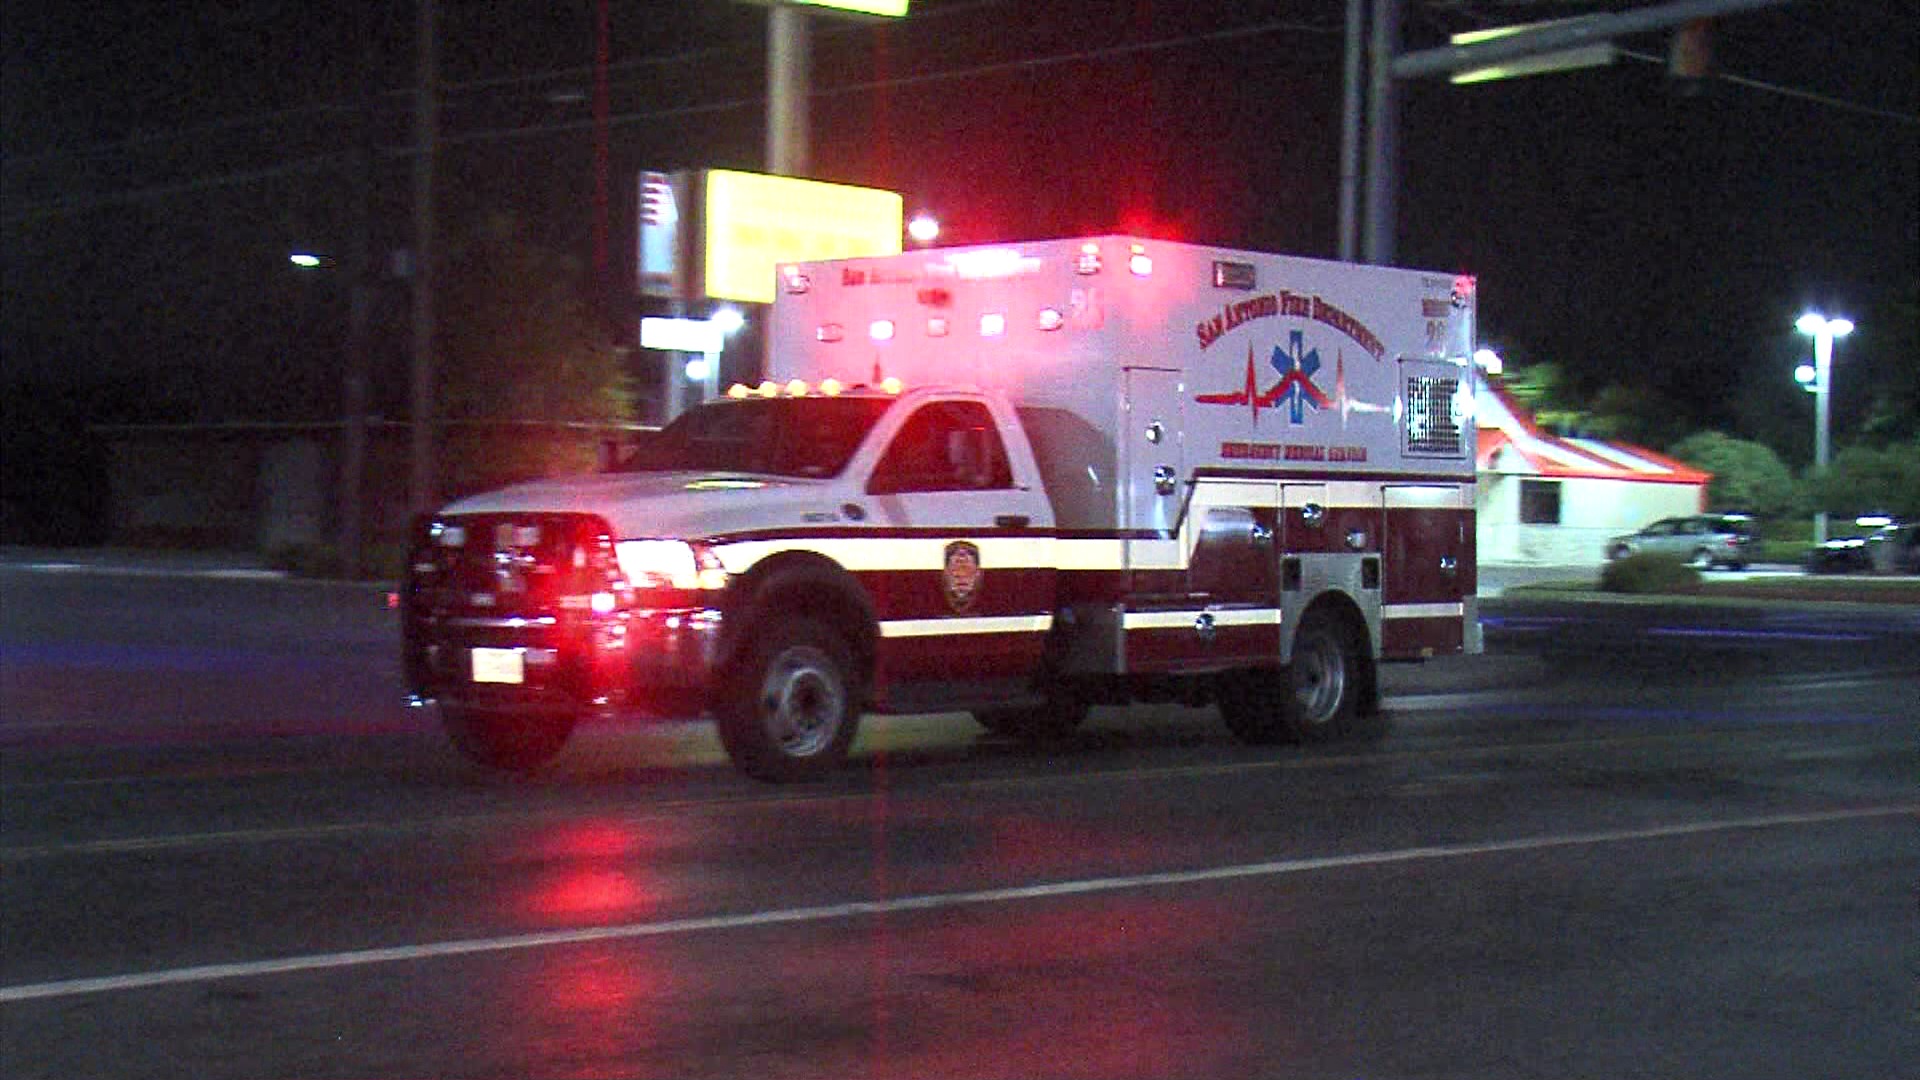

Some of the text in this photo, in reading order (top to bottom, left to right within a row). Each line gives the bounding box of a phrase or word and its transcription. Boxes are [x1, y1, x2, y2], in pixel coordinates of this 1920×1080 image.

[1197, 314, 1224, 351] SAN
[1279, 290, 1310, 316] FIRE
[1313, 295, 1385, 361] DEPARTMENT
